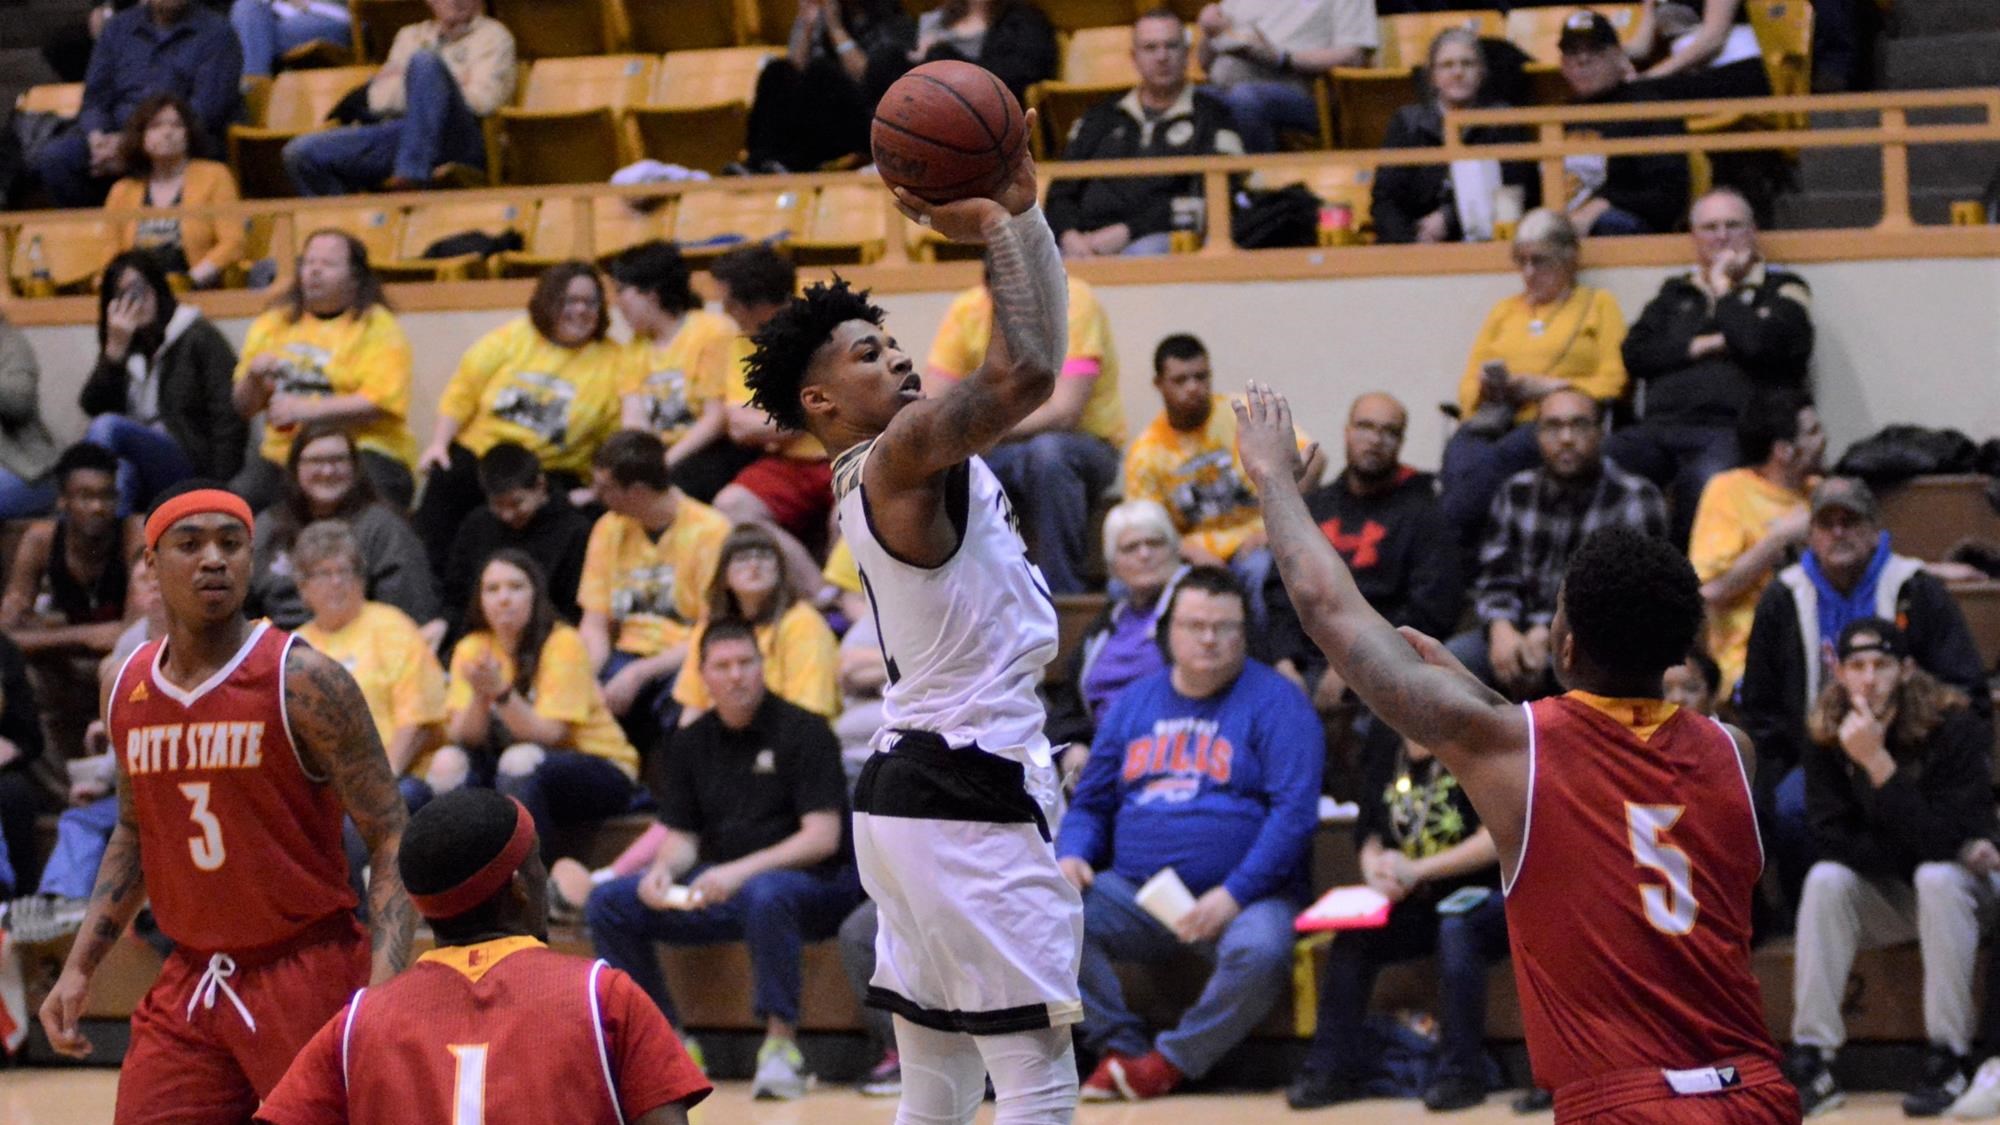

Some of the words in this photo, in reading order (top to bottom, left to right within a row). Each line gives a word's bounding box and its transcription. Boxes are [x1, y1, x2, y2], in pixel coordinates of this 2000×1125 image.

[127, 723, 183, 776] PITT
[185, 720, 266, 769] STATE
[1122, 734, 1233, 785] BILLS
[177, 781, 226, 871] 3
[1623, 800, 1700, 936] 5
[445, 1041, 489, 1125] 1
